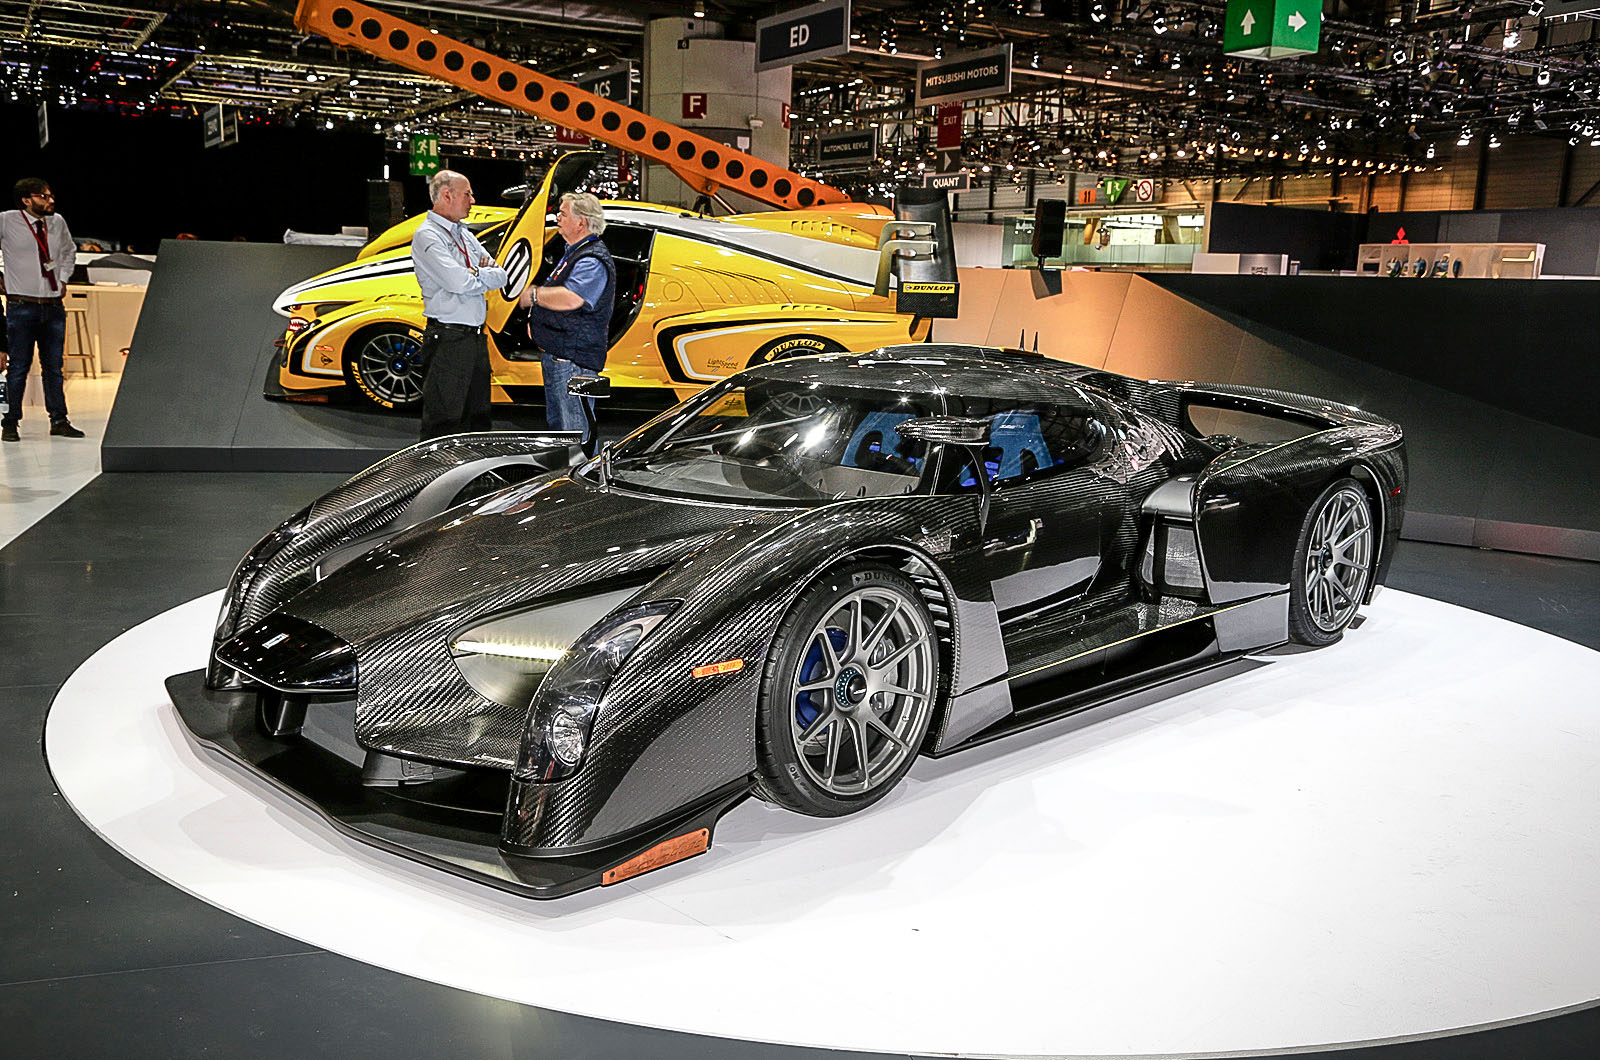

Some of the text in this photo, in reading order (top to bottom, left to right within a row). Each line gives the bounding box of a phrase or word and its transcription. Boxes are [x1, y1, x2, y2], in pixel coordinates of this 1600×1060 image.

[790, 24, 810, 48] ED
[925, 64, 999, 87] MITSUBISHI MOTORS
[594, 80, 611, 97] ACS
[689, 95, 702, 113] F
[943, 115, 958, 126] EXIT
[932, 176, 960, 189] QUANT
[772, 339, 822, 356] DUNLOP
[863, 571, 913, 591] DUNLOP
